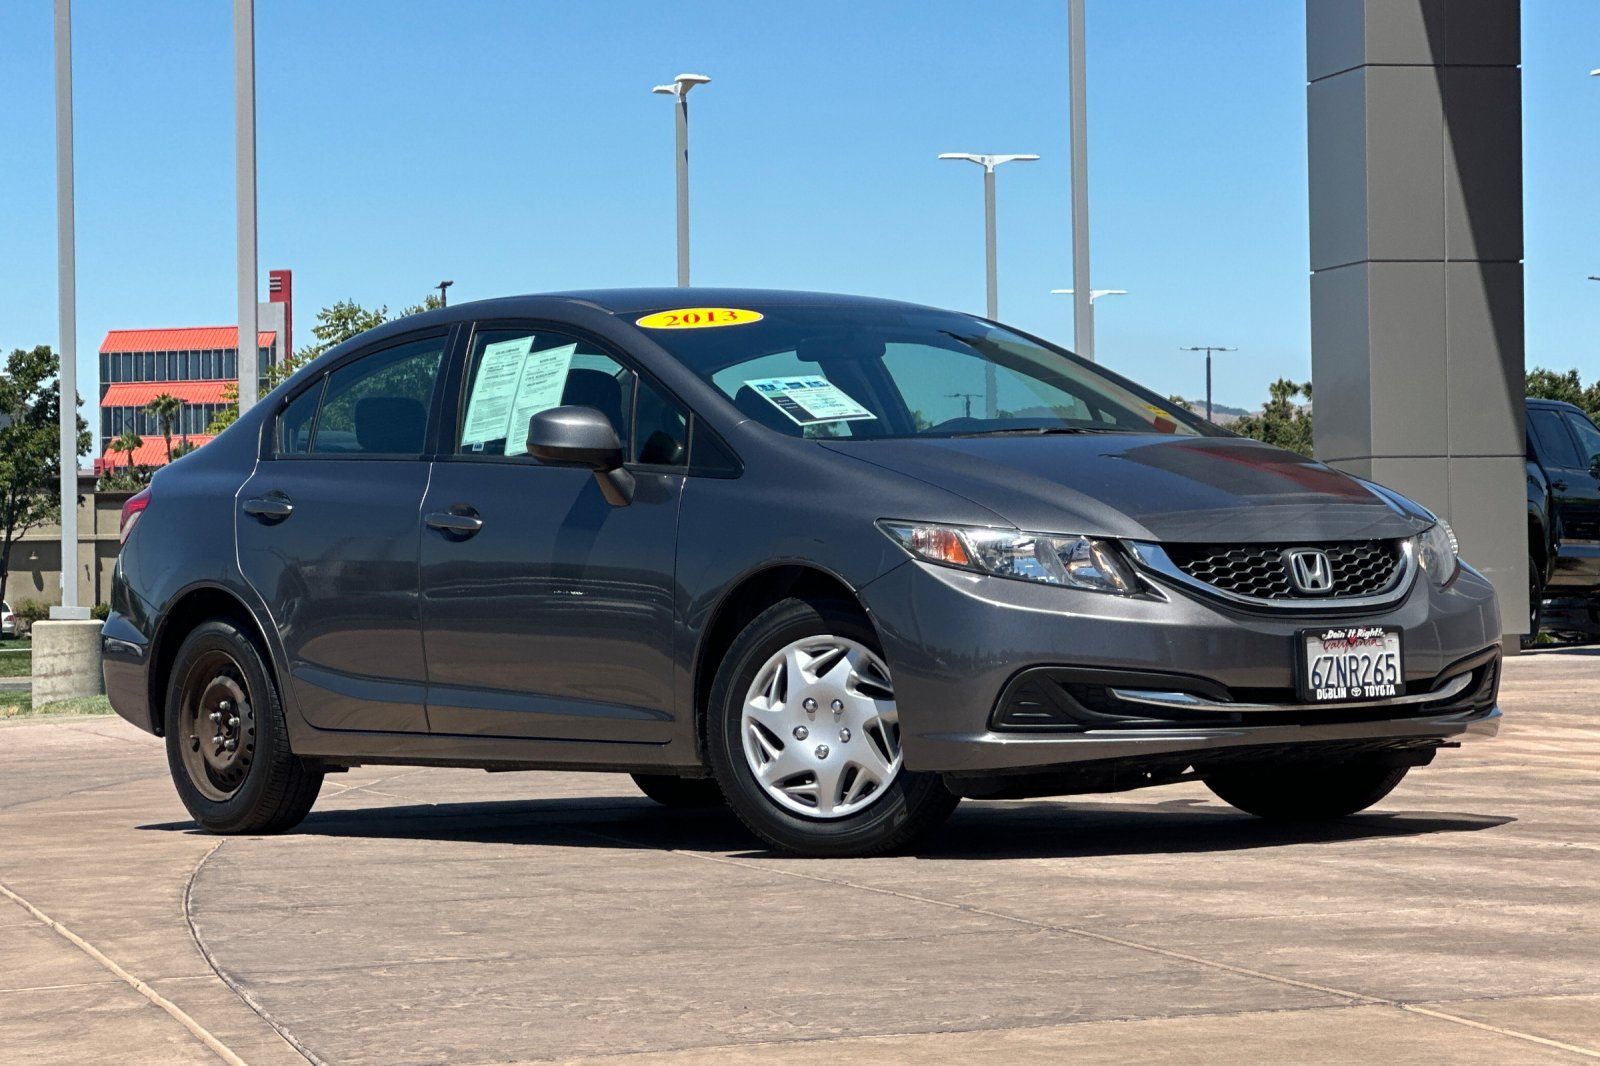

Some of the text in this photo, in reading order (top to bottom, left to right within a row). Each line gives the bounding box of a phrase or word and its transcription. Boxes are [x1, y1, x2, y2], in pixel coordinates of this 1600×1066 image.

[663, 310, 738, 327] 2013
[1323, 638, 1383, 654] Califrnia
[1311, 653, 1397, 689] 6ZNR265
[1317, 684, 1396, 700] DUBLIN TOYOTA
